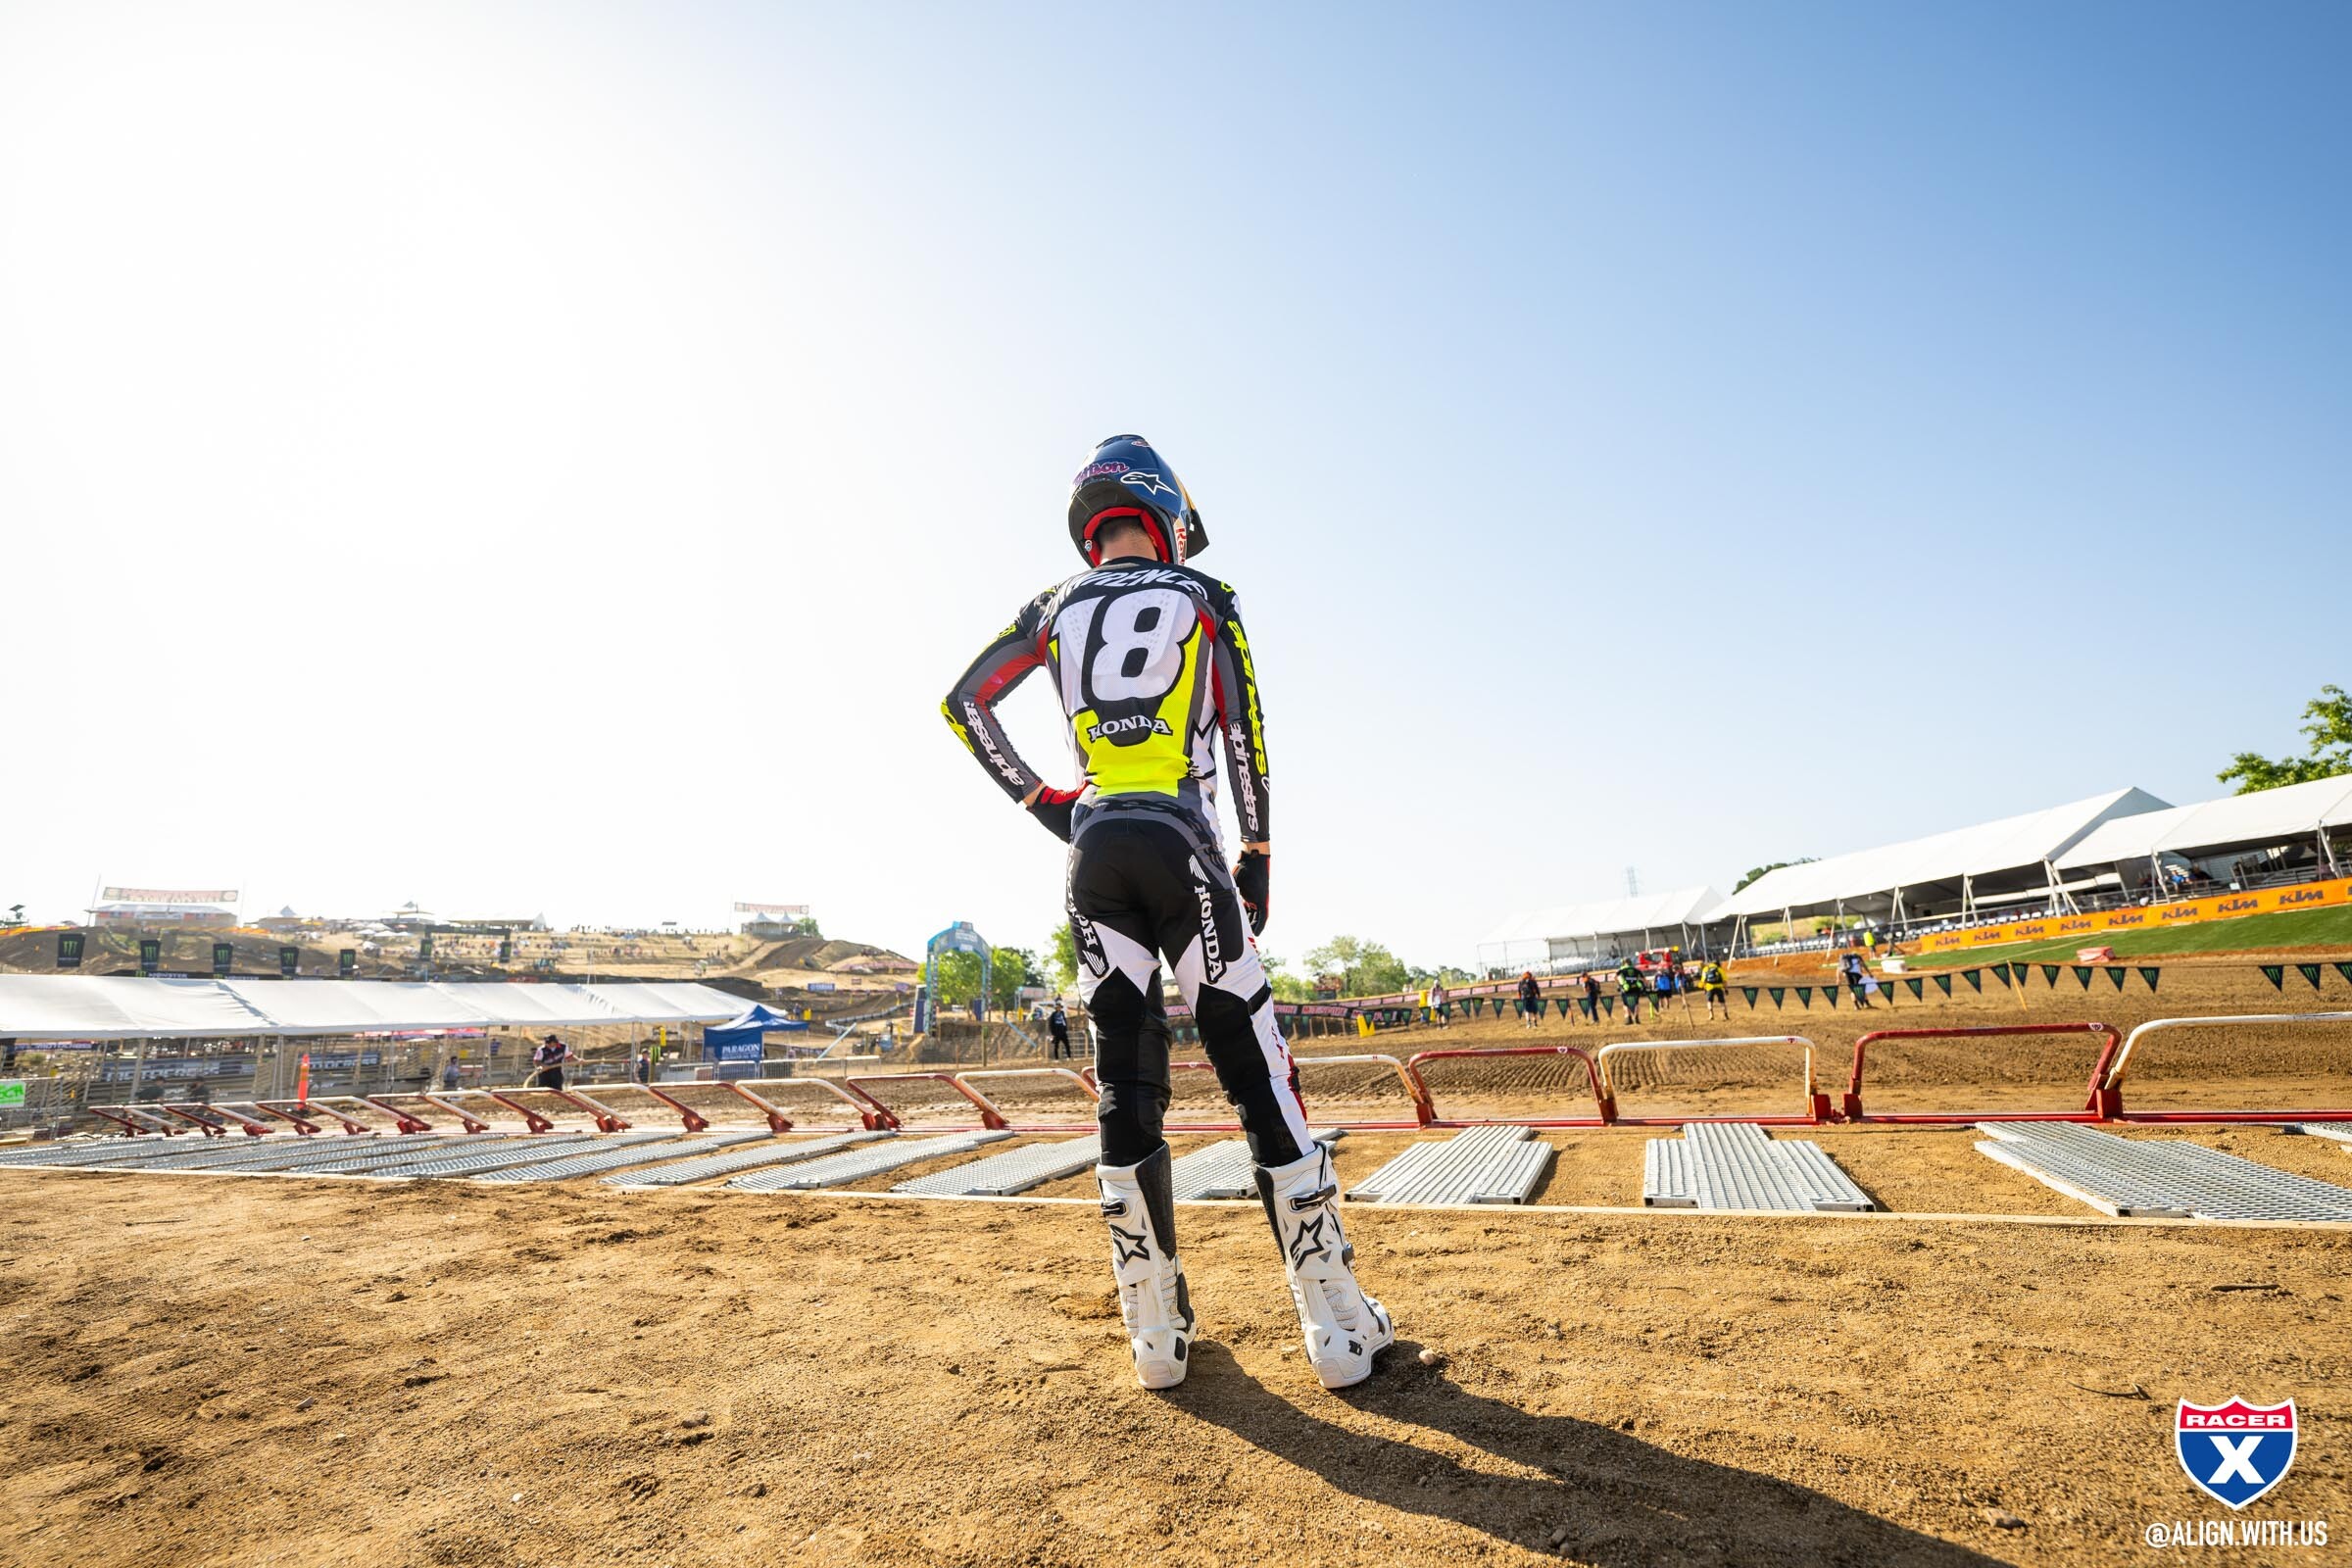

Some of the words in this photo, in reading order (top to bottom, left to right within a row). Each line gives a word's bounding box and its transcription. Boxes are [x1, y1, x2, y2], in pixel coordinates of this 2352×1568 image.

[1051, 588, 1197, 717] 18
[1089, 715, 1172, 741] HONDA
[1195, 885, 1223, 980] HONDA
[1936, 936, 1960, 947] KTM
[1974, 930, 2000, 941] KTM
[2015, 925, 2044, 936] KTM
[2060, 919, 2092, 931] KTM
[2109, 914, 2143, 925] KTM
[2162, 907, 2198, 919] KTM
[2218, 899, 2258, 912] KTM
[2278, 890, 2324, 905] KTM
[721, 1044, 760, 1054] PARAGON
